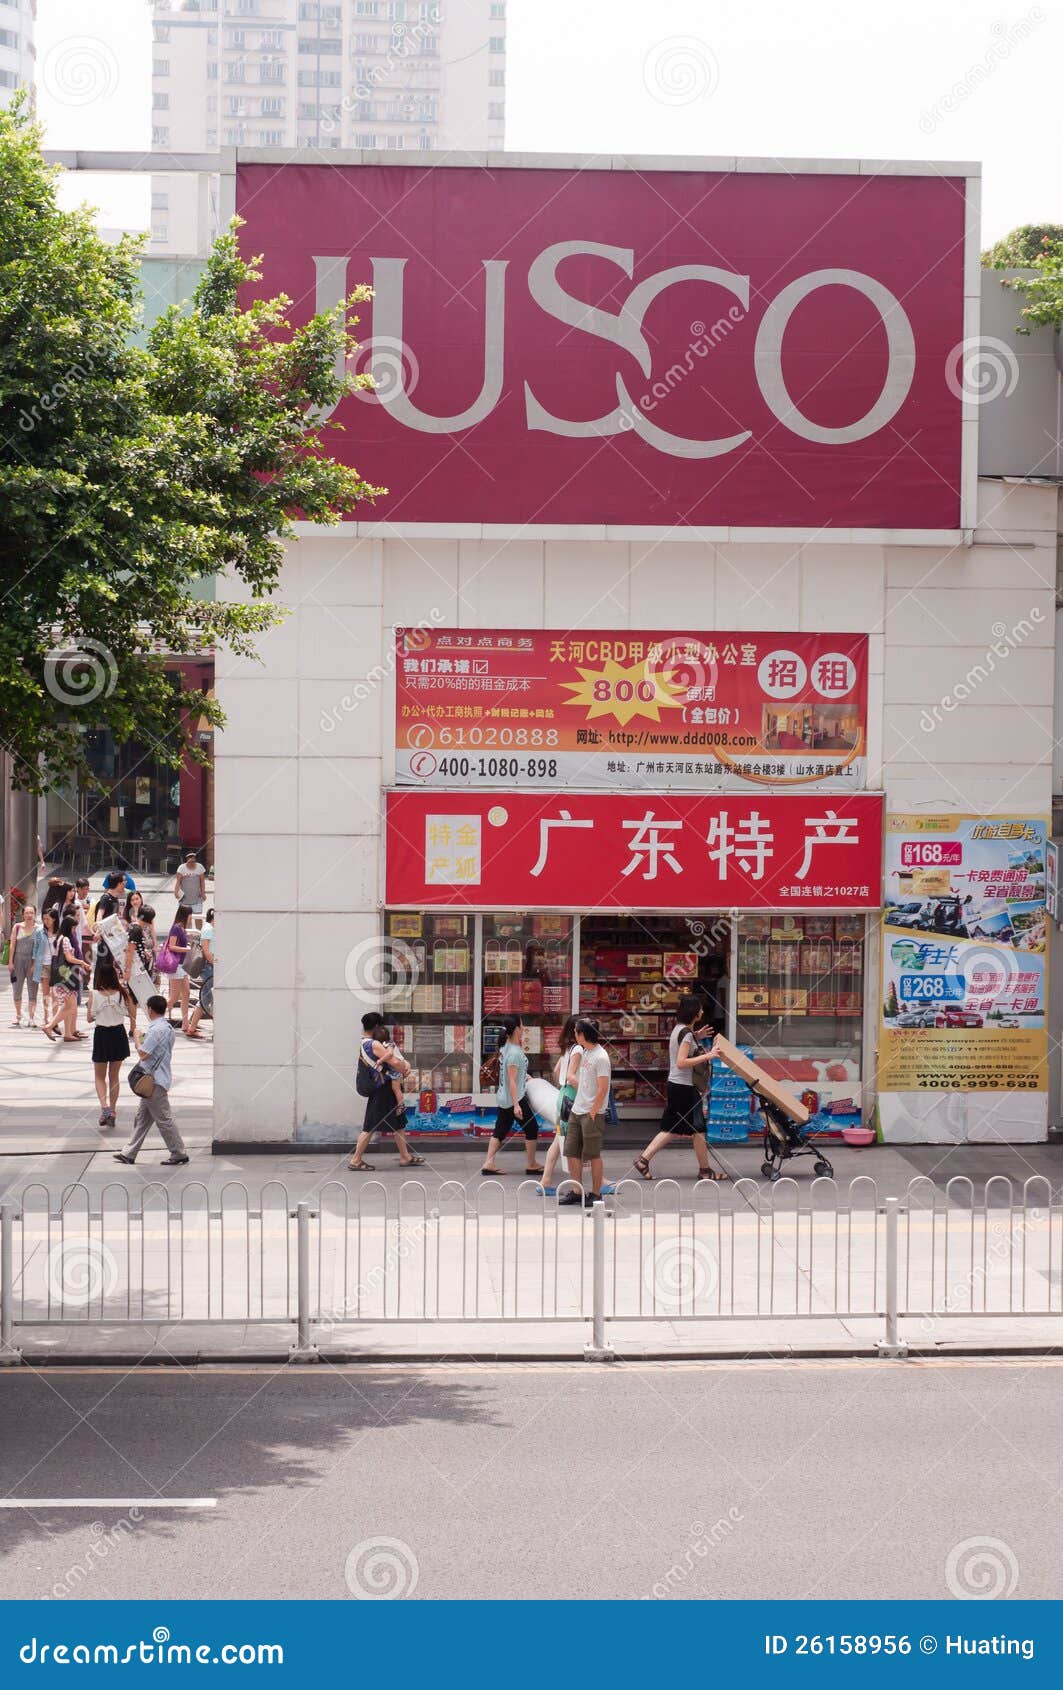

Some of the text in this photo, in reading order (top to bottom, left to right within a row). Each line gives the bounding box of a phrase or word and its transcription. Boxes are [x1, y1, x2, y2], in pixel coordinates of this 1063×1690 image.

[287, 240, 916, 459] JUSCO
[437, 636, 533, 647] 点对点商务
[550, 641, 757, 665] 天河CBD甲级小型办公室
[403, 658, 470, 673] 我们承诺
[768, 659, 848, 691] 招租
[405, 678, 531, 691] 只需20%的的租金成本
[593, 679, 656, 702] 800
[439, 727, 559, 746] 61020888
[609, 731, 757, 747] http://www.ddd008.com
[439, 758, 557, 777] 400-1080-898
[530, 810, 859, 880] 广东特产
[912, 844, 942, 863] 168
[779, 886, 869, 897] 全国连锁之1027店
[913, 978, 944, 997] 268
[918, 1080, 1038, 1088] 4006-999-688
